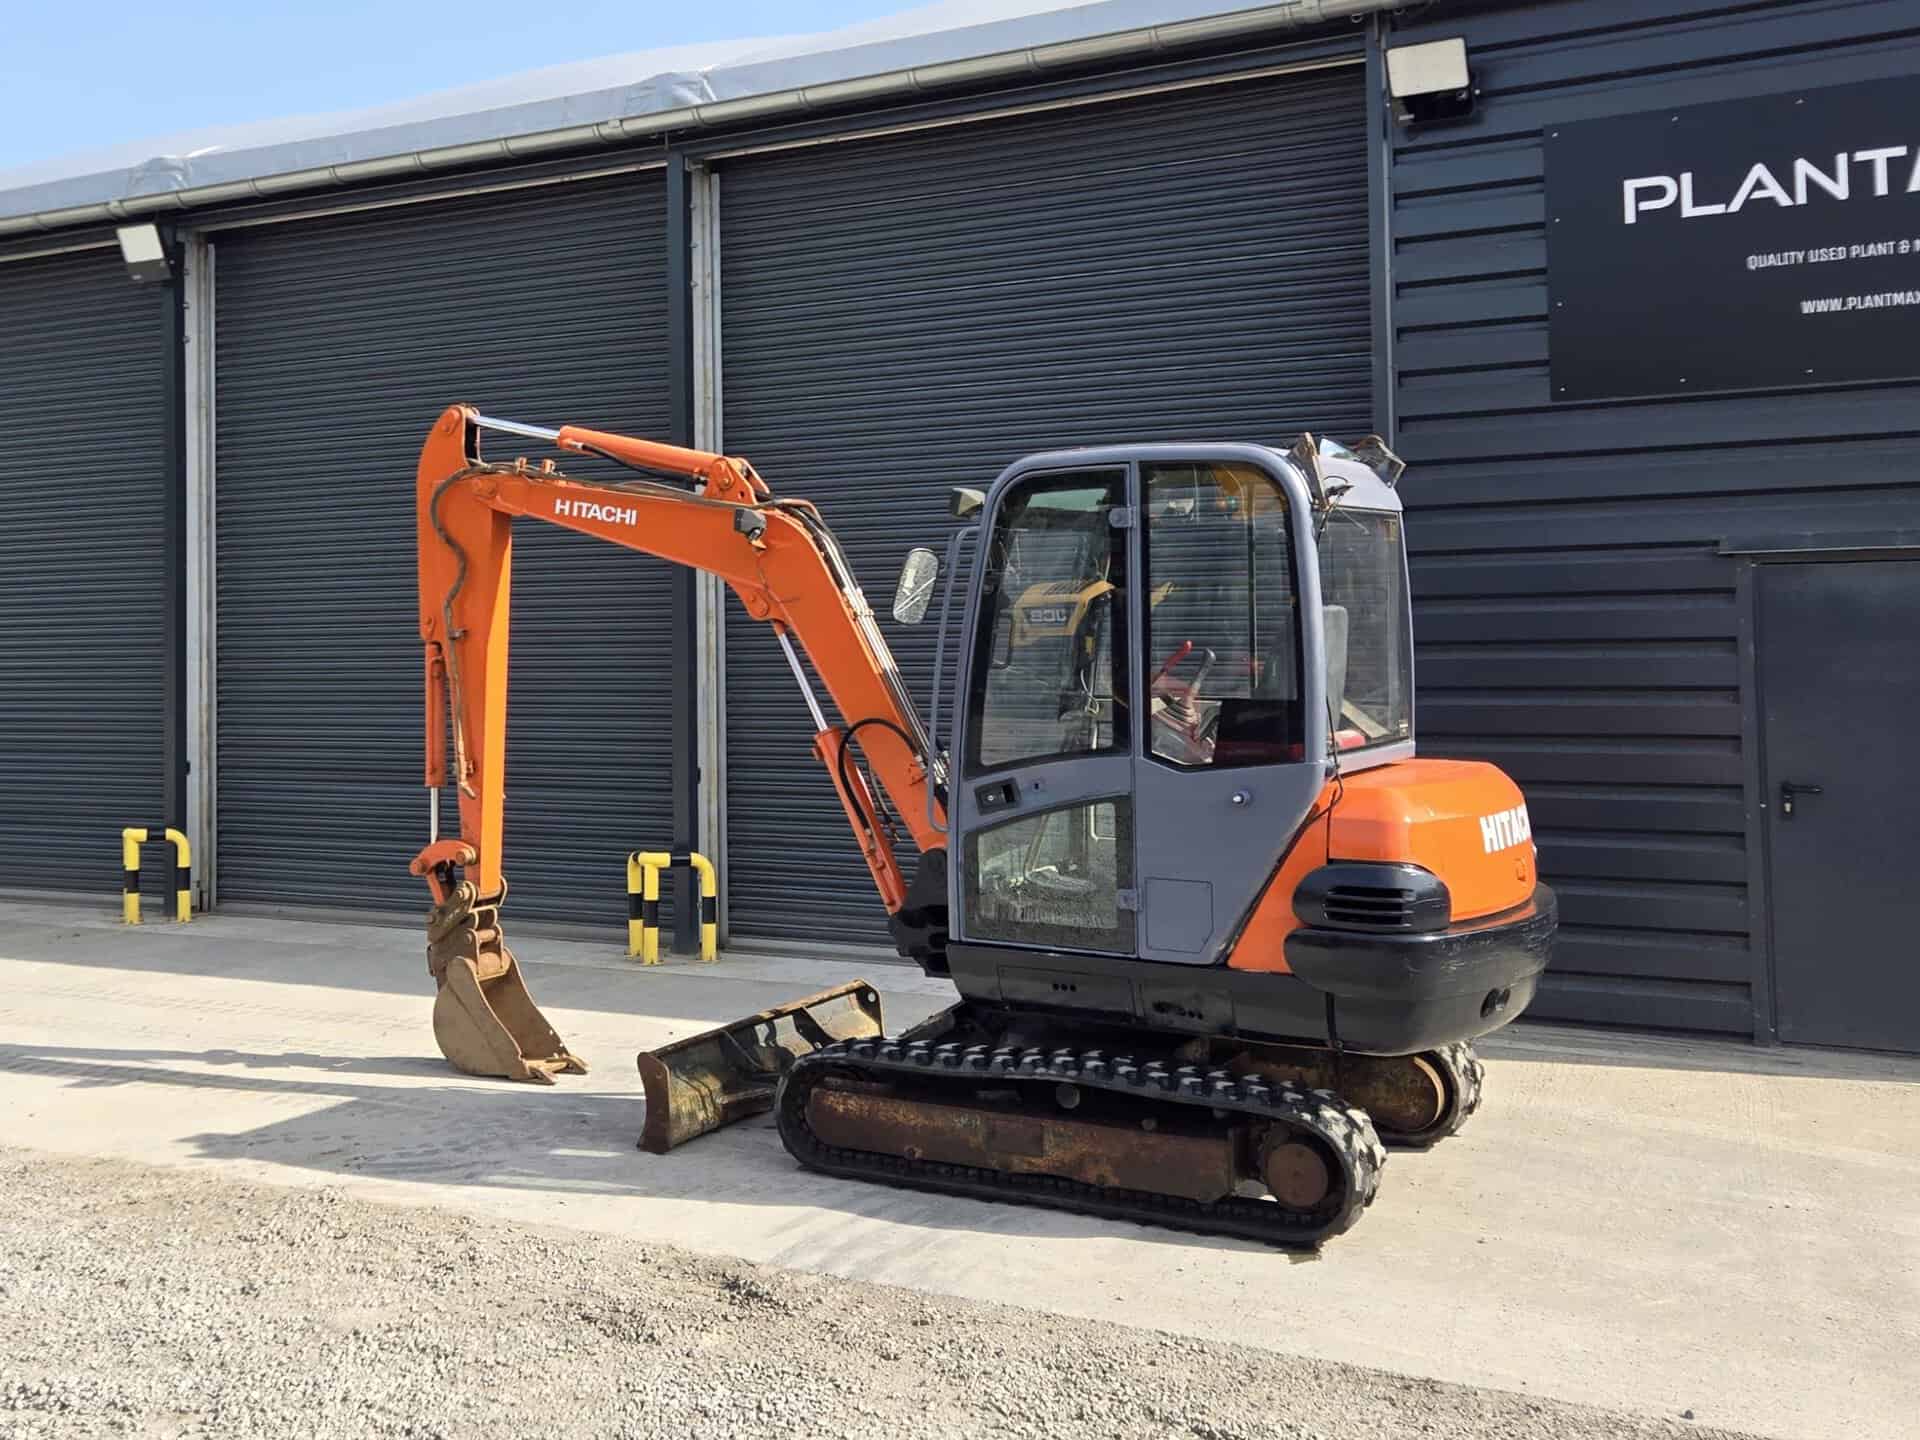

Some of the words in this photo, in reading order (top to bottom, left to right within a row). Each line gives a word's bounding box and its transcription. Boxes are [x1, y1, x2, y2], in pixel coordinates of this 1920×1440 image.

[1624, 145, 1920, 224] PLANT
[1746, 249, 1806, 270] QUALITY
[1807, 247, 1847, 263] USED
[1849, 240, 1897, 259] PLANT
[1898, 239, 1911, 254] &
[555, 498, 638, 526] HITACHI
